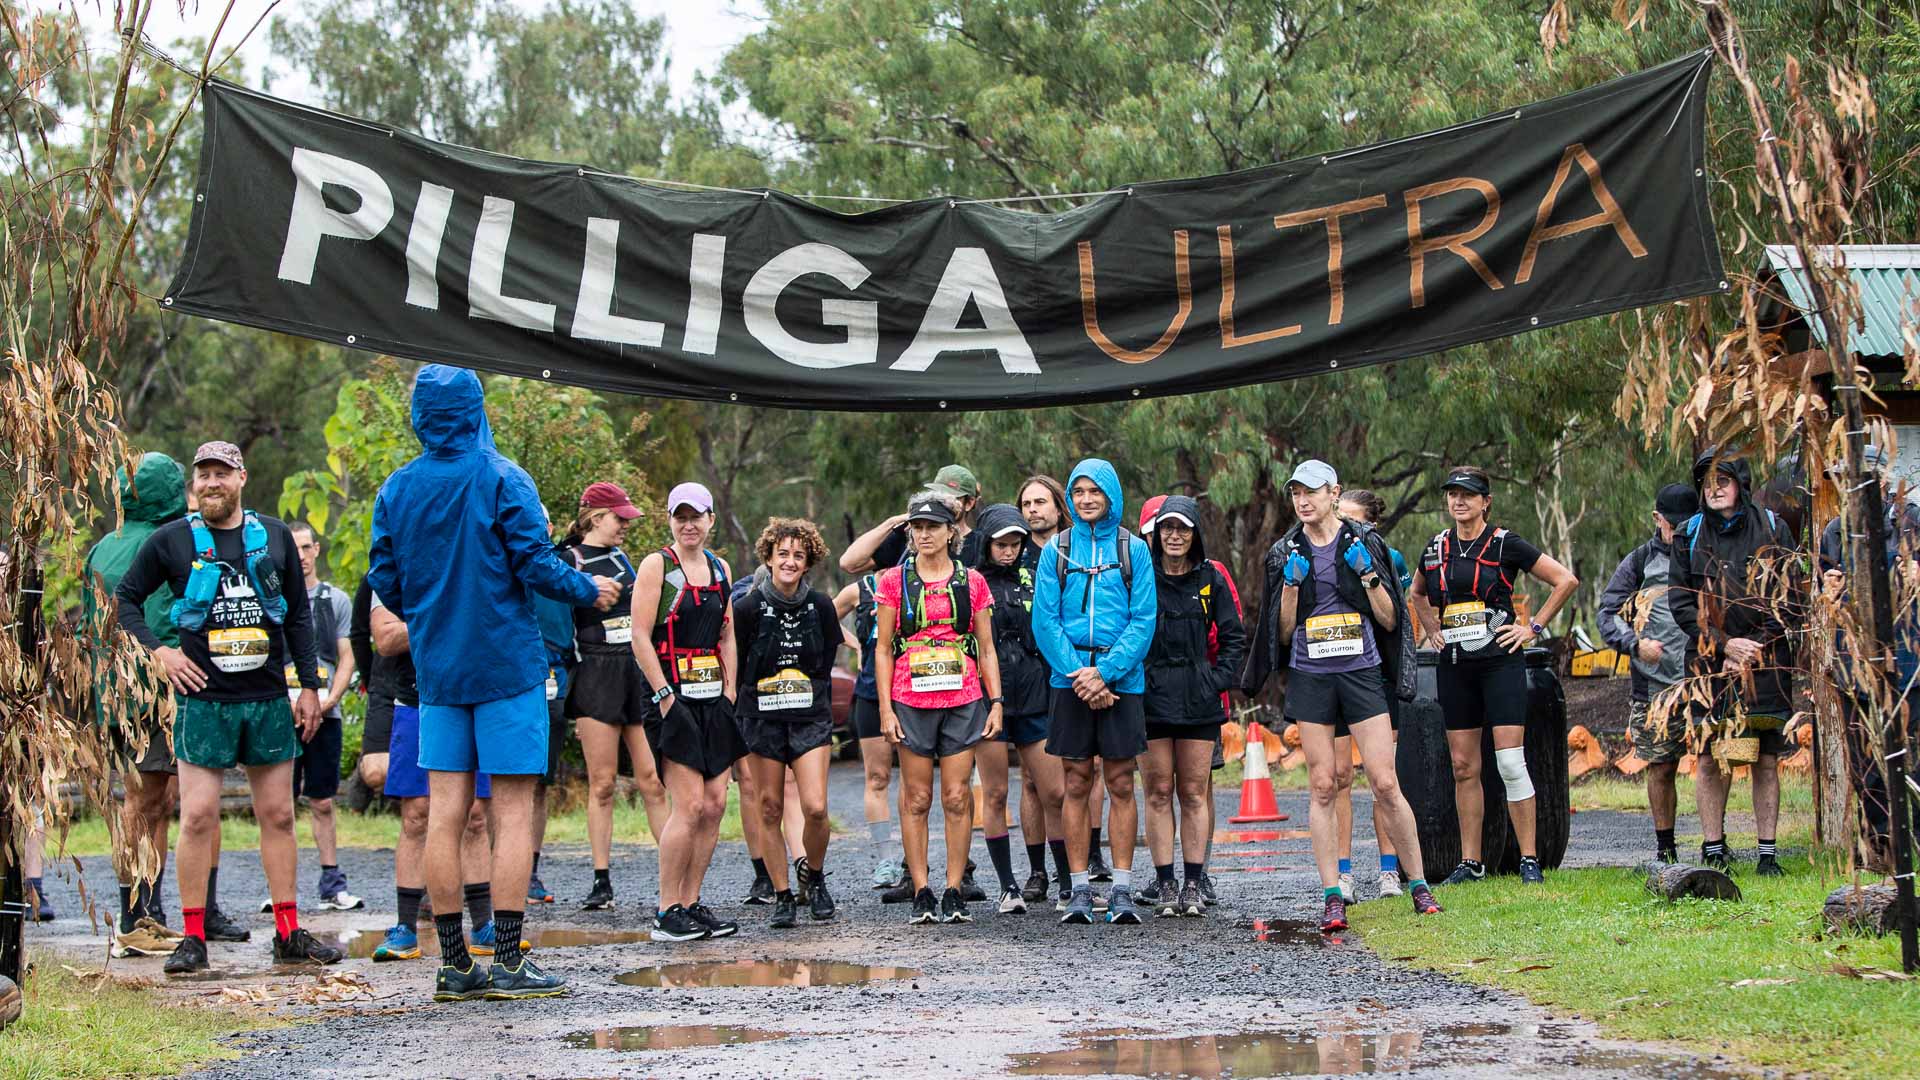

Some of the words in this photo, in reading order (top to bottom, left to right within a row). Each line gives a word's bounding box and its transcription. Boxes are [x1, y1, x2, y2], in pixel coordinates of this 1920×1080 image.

[277, 147, 1042, 375] PILLIGA
[1077, 143, 1648, 364] ULTRA
[239, 616, 261, 625] CLUB
[1454, 615, 1468, 627] 59
[1326, 627, 1344, 640] 24
[231, 641, 249, 655] 87
[699, 669, 712, 682] 34
[928, 662, 946, 676] 30
[776, 680, 794, 693] 36
